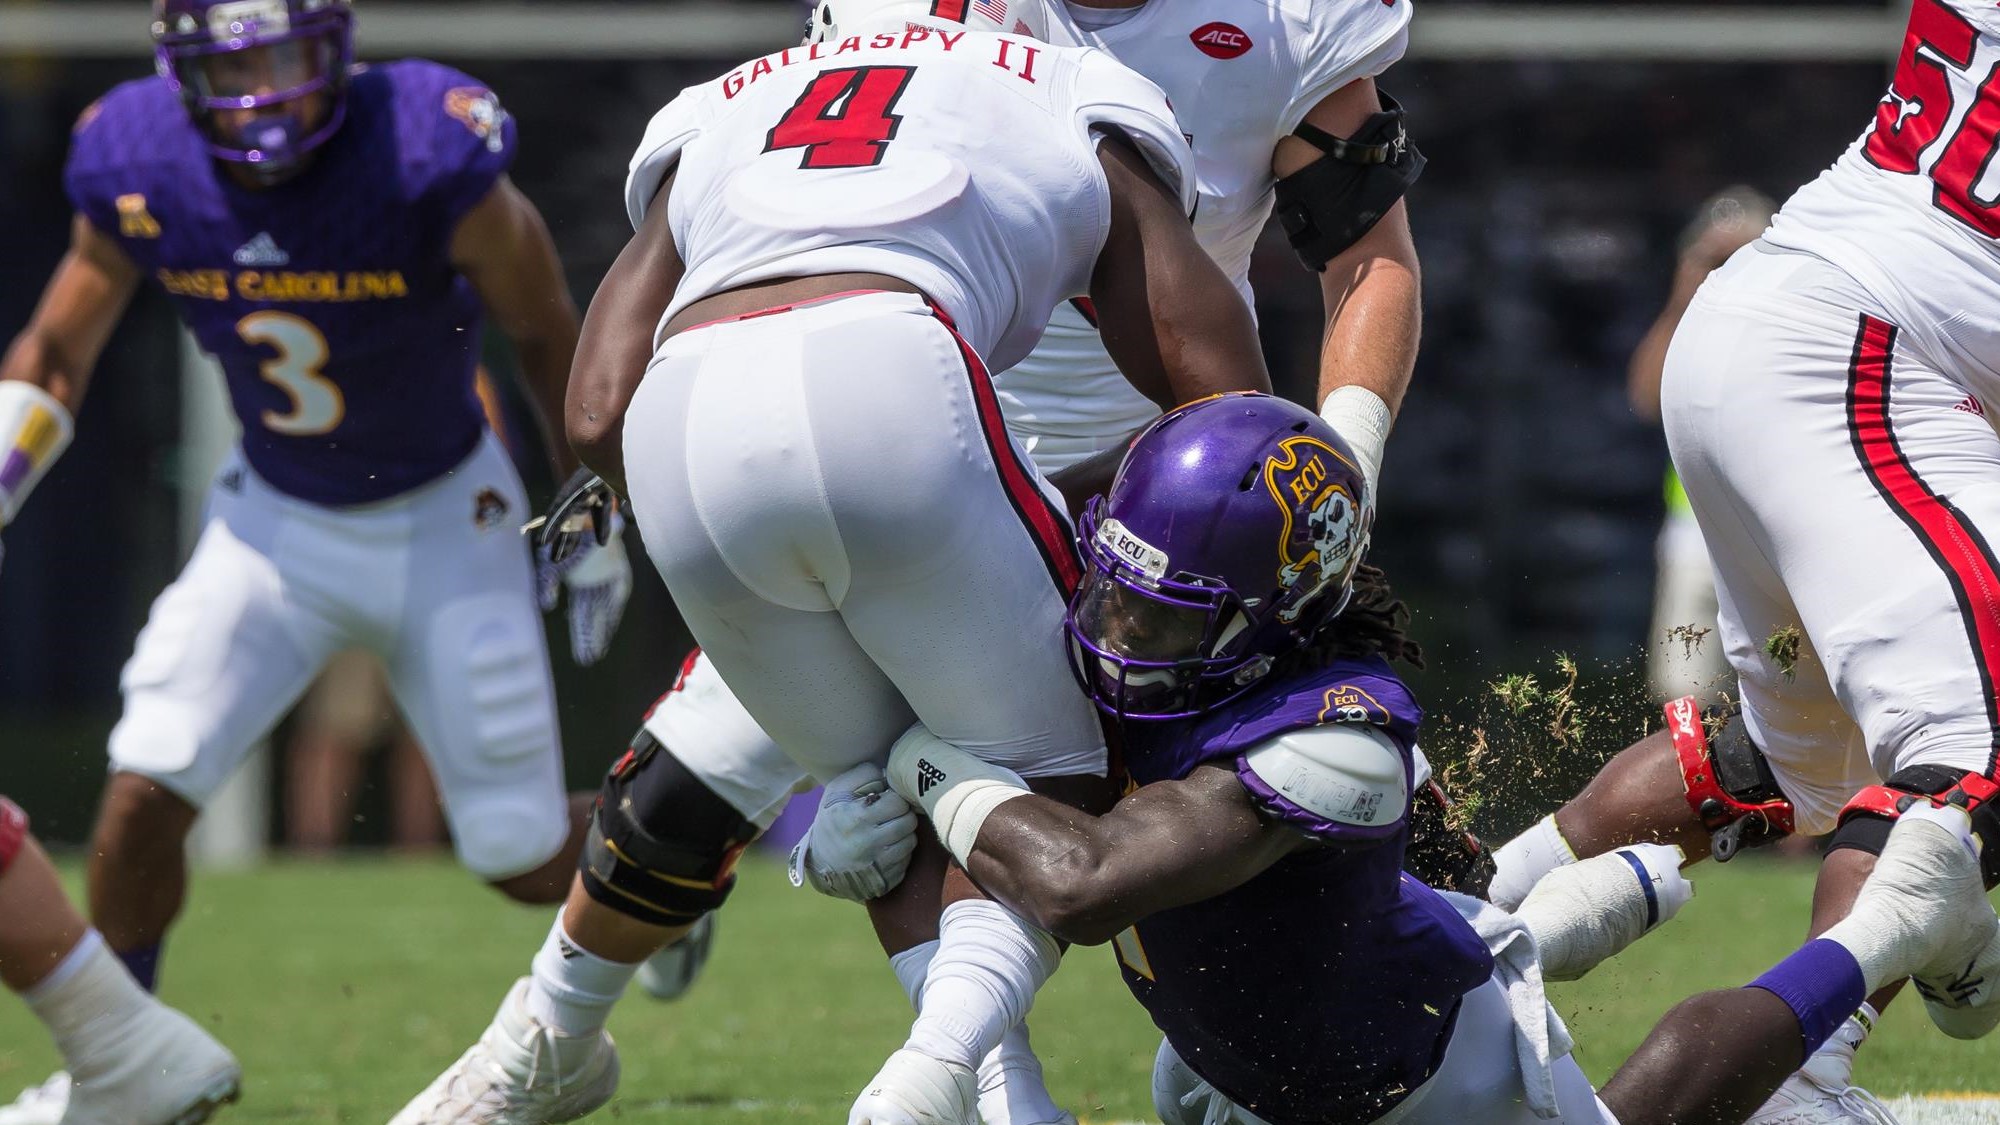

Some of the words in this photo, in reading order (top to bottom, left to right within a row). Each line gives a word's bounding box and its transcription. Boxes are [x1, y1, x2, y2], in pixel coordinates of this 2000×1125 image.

[1199, 30, 1245, 47] ACC
[722, 31, 967, 100] GALLASPY
[992, 38, 1041, 84] II
[760, 65, 918, 170] 4
[235, 310, 346, 436] 3
[1290, 454, 1326, 505] ECU
[1117, 534, 1146, 560] ECU
[1334, 694, 1359, 706] ECU
